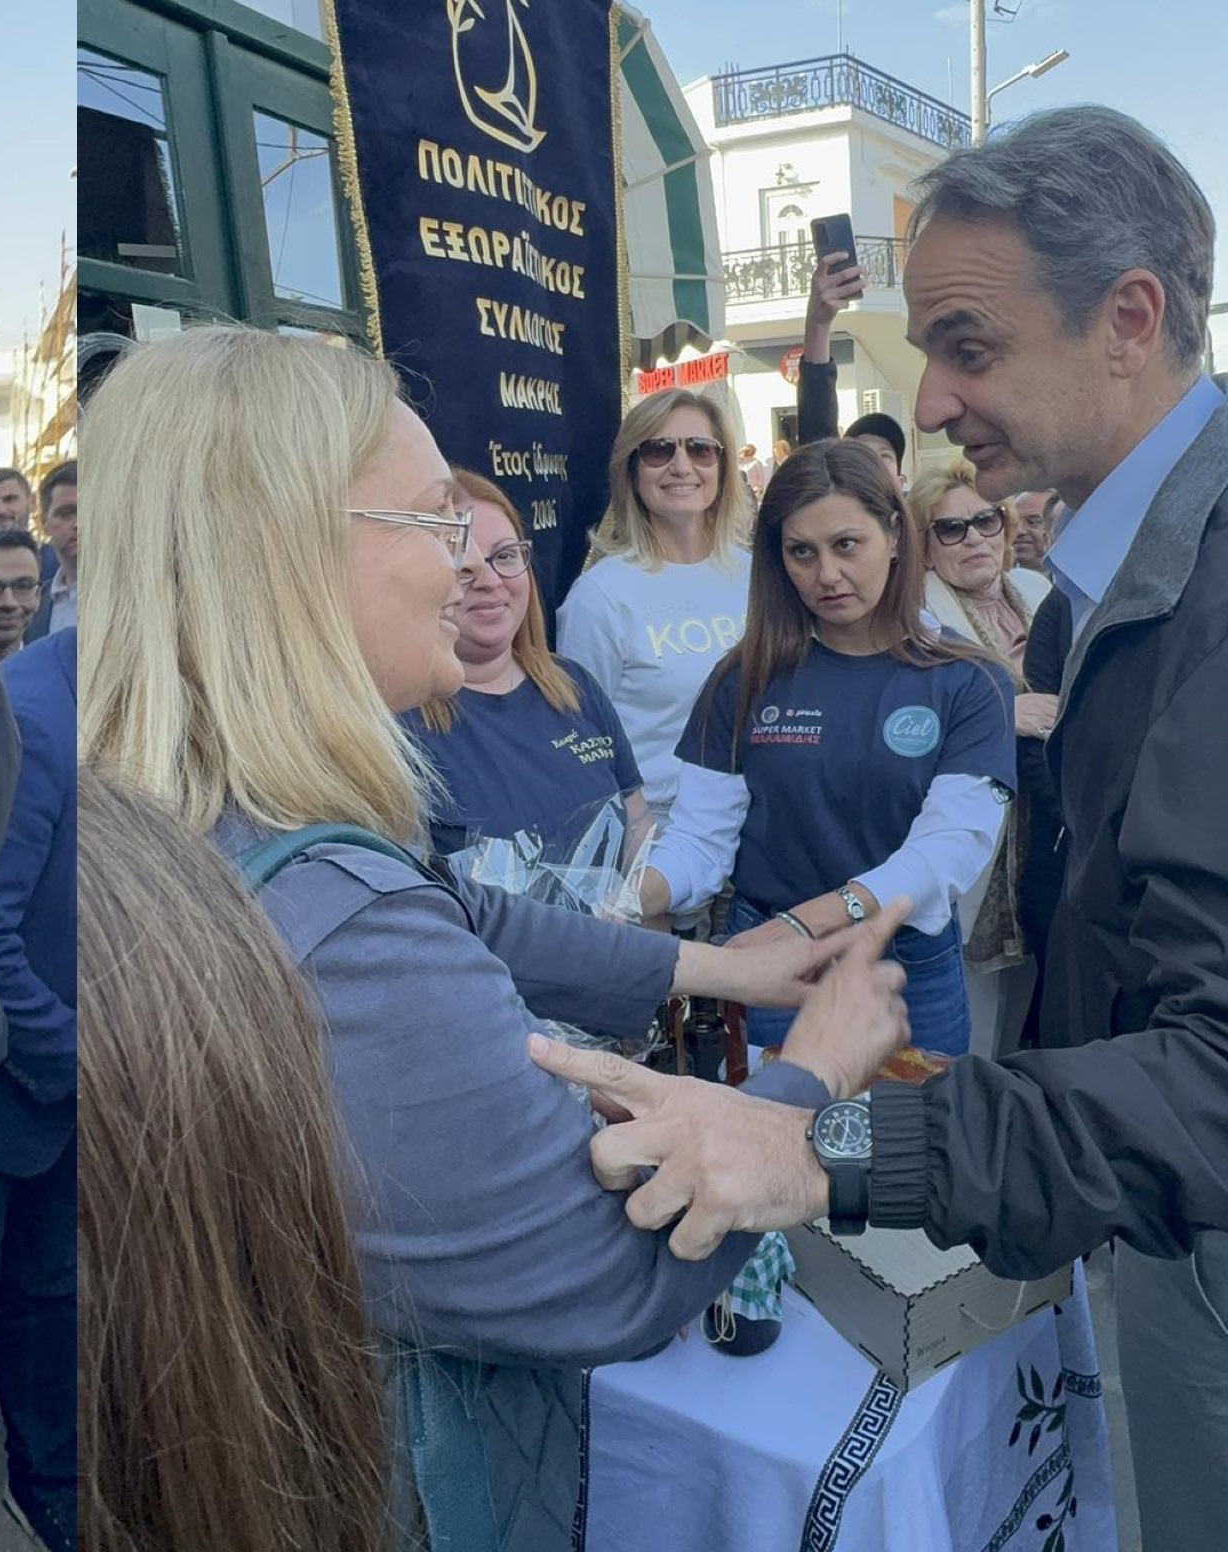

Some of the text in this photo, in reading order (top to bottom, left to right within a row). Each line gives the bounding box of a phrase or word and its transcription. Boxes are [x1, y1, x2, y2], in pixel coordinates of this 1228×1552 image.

[476, 297, 565, 355] ΣΥΛΛΟΓΟΣ
[500, 371, 562, 415] ΜΑΚΡΗΣ
[638, 352, 730, 395] SUPER MARKET
[489, 440, 532, 482] Έτος
[532, 498, 557, 531] 2006
[752, 725, 824, 735] SUPER MARKET
[893, 714, 933, 736] Ciel
